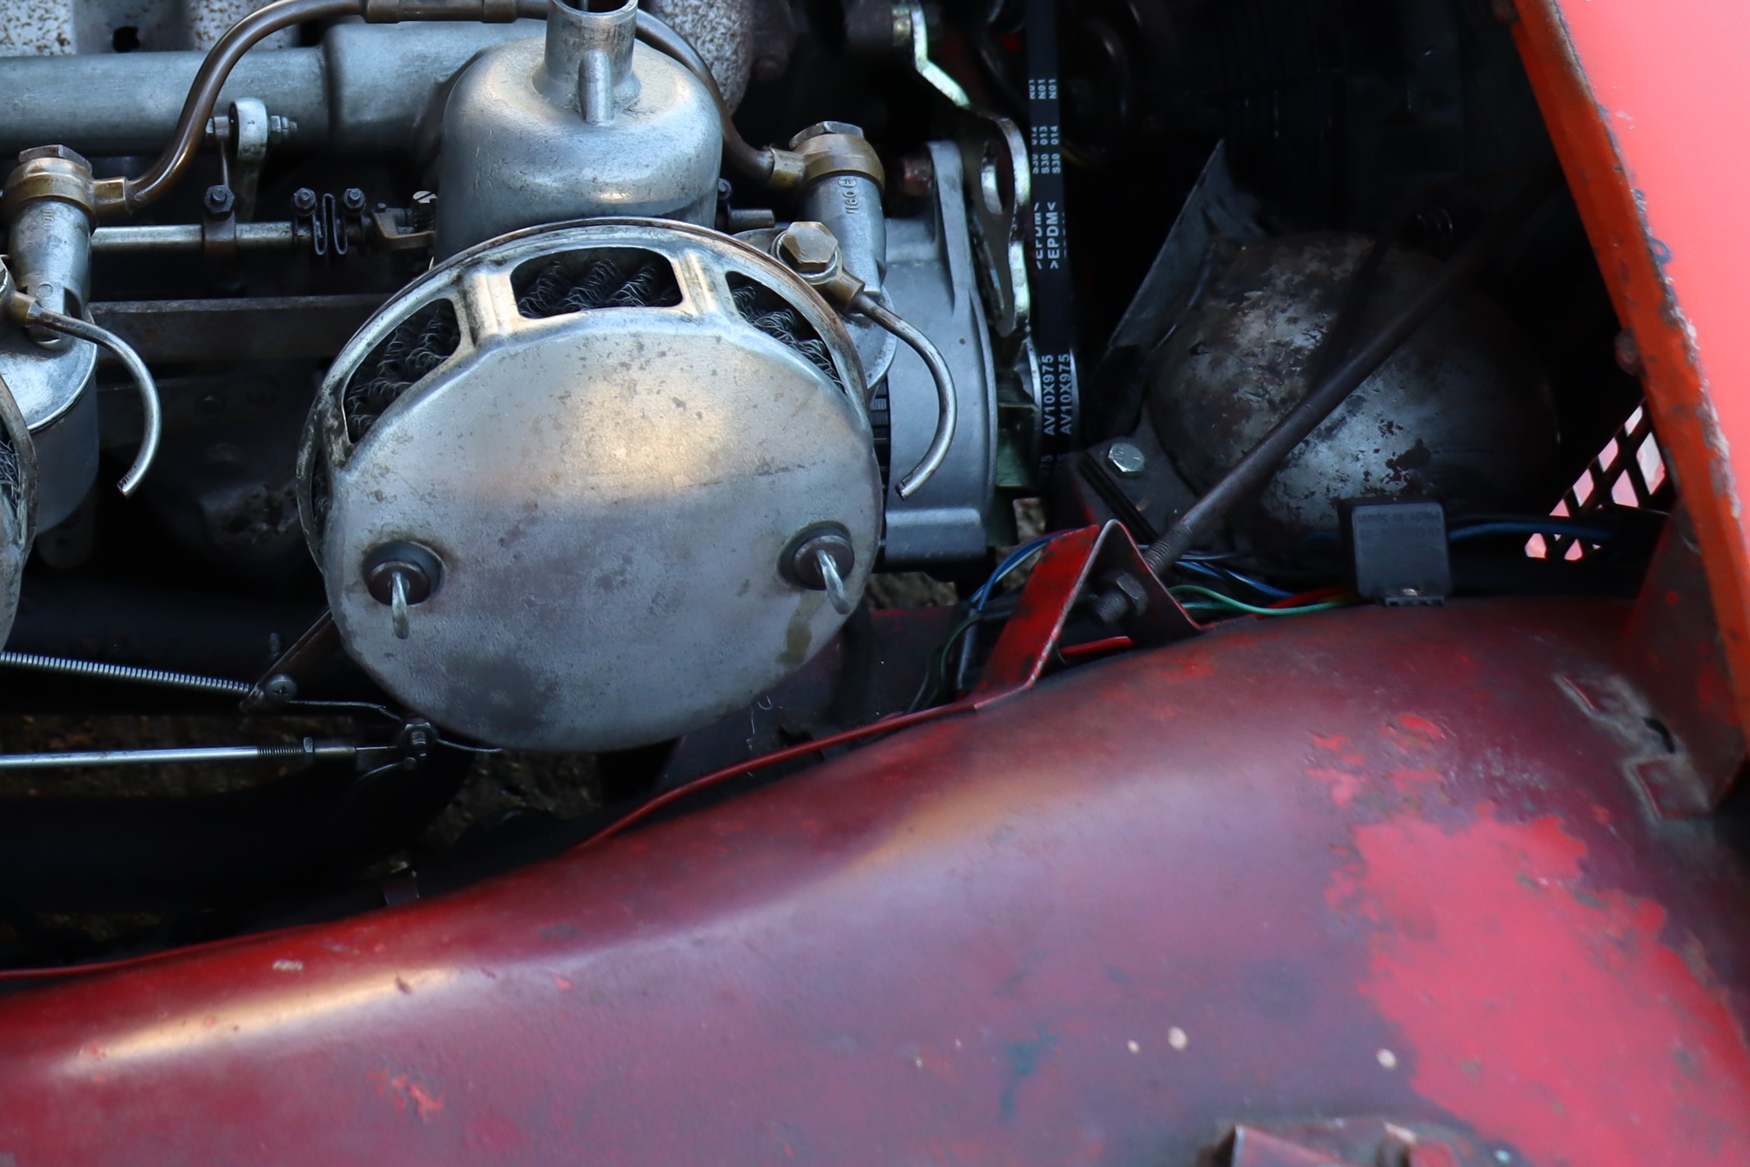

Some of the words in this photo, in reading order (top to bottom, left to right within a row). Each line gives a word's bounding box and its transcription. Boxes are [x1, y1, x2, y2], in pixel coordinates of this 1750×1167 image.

[1037, 79, 1047, 100] N01
[1048, 79, 1058, 100] N01
[1039, 126, 1049, 146] 013
[1050, 125, 1060, 146] 014
[1040, 153, 1050, 175] S30
[1051, 153, 1062, 175] S30
[1041, 354, 1056, 436] AV10X975
[1058, 353, 1073, 435] AV10X975
